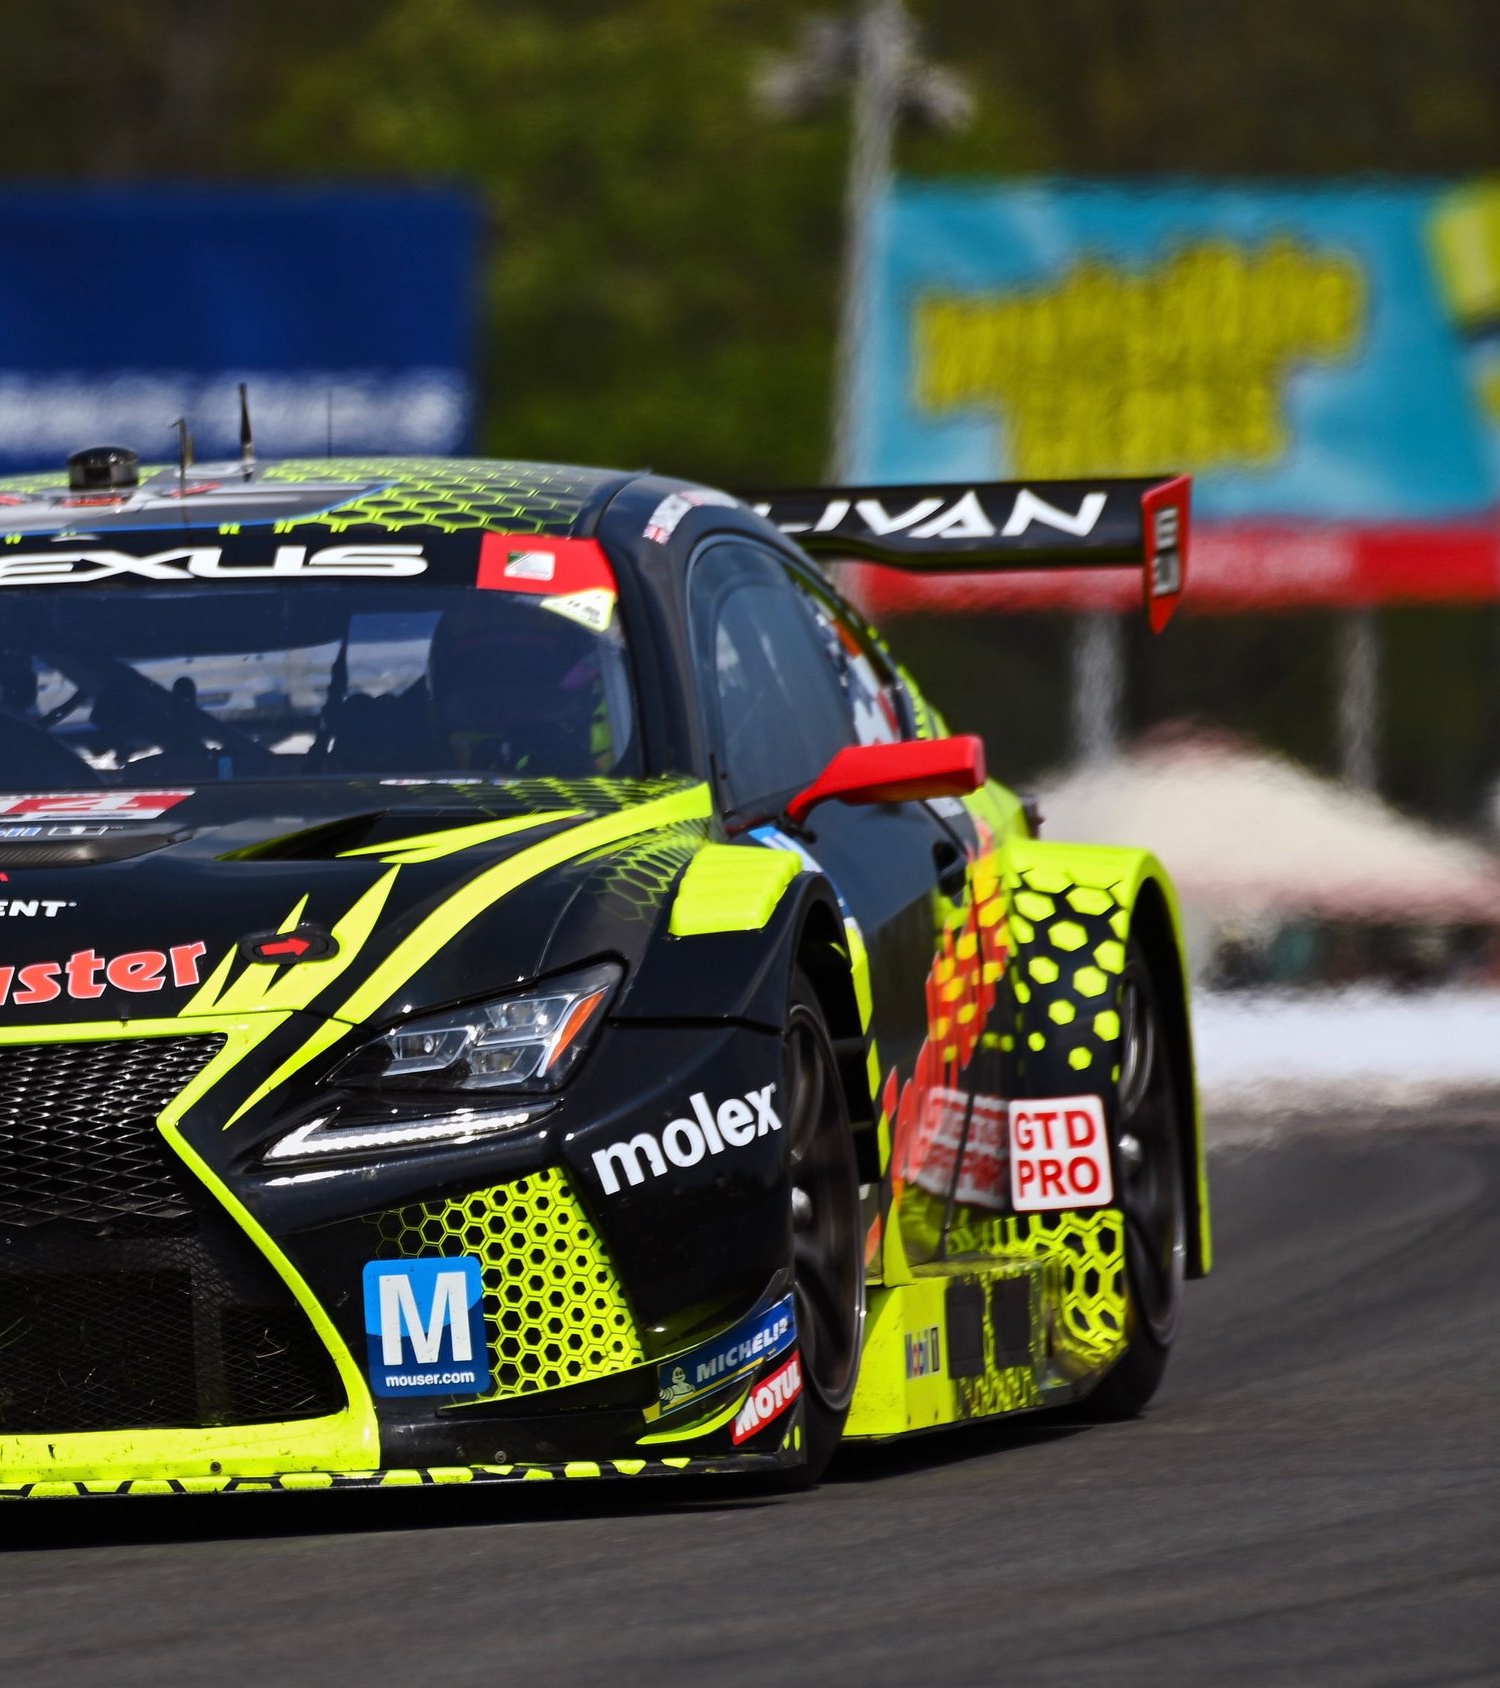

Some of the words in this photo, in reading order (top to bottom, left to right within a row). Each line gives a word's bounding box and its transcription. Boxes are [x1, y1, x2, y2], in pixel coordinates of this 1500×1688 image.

[591, 1085, 783, 1196] molex
[1014, 1109, 1096, 1151] GTD
[1017, 1156, 1101, 1199] PRO
[378, 1271, 473, 1366] M
[385, 1371, 475, 1388] mouser.com
[735, 1361, 802, 1437] MOTUL
